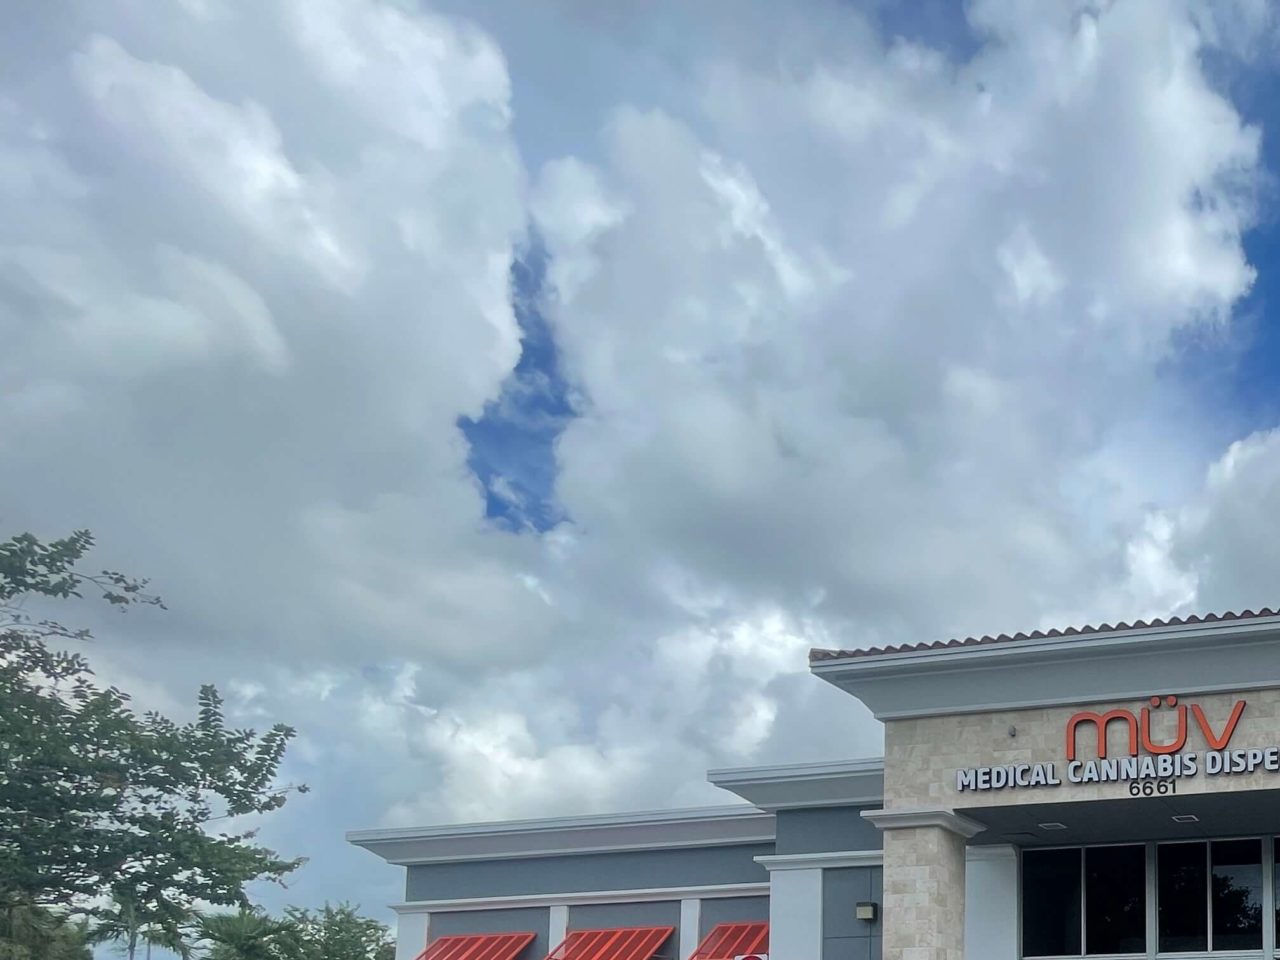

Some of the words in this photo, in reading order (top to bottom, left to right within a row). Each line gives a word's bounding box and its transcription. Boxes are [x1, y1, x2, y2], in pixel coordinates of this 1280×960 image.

[957, 762, 1061, 792] MEDICAL
[1067, 752, 1198, 784] CANNABIS
[1129, 778, 1177, 797] 6661
